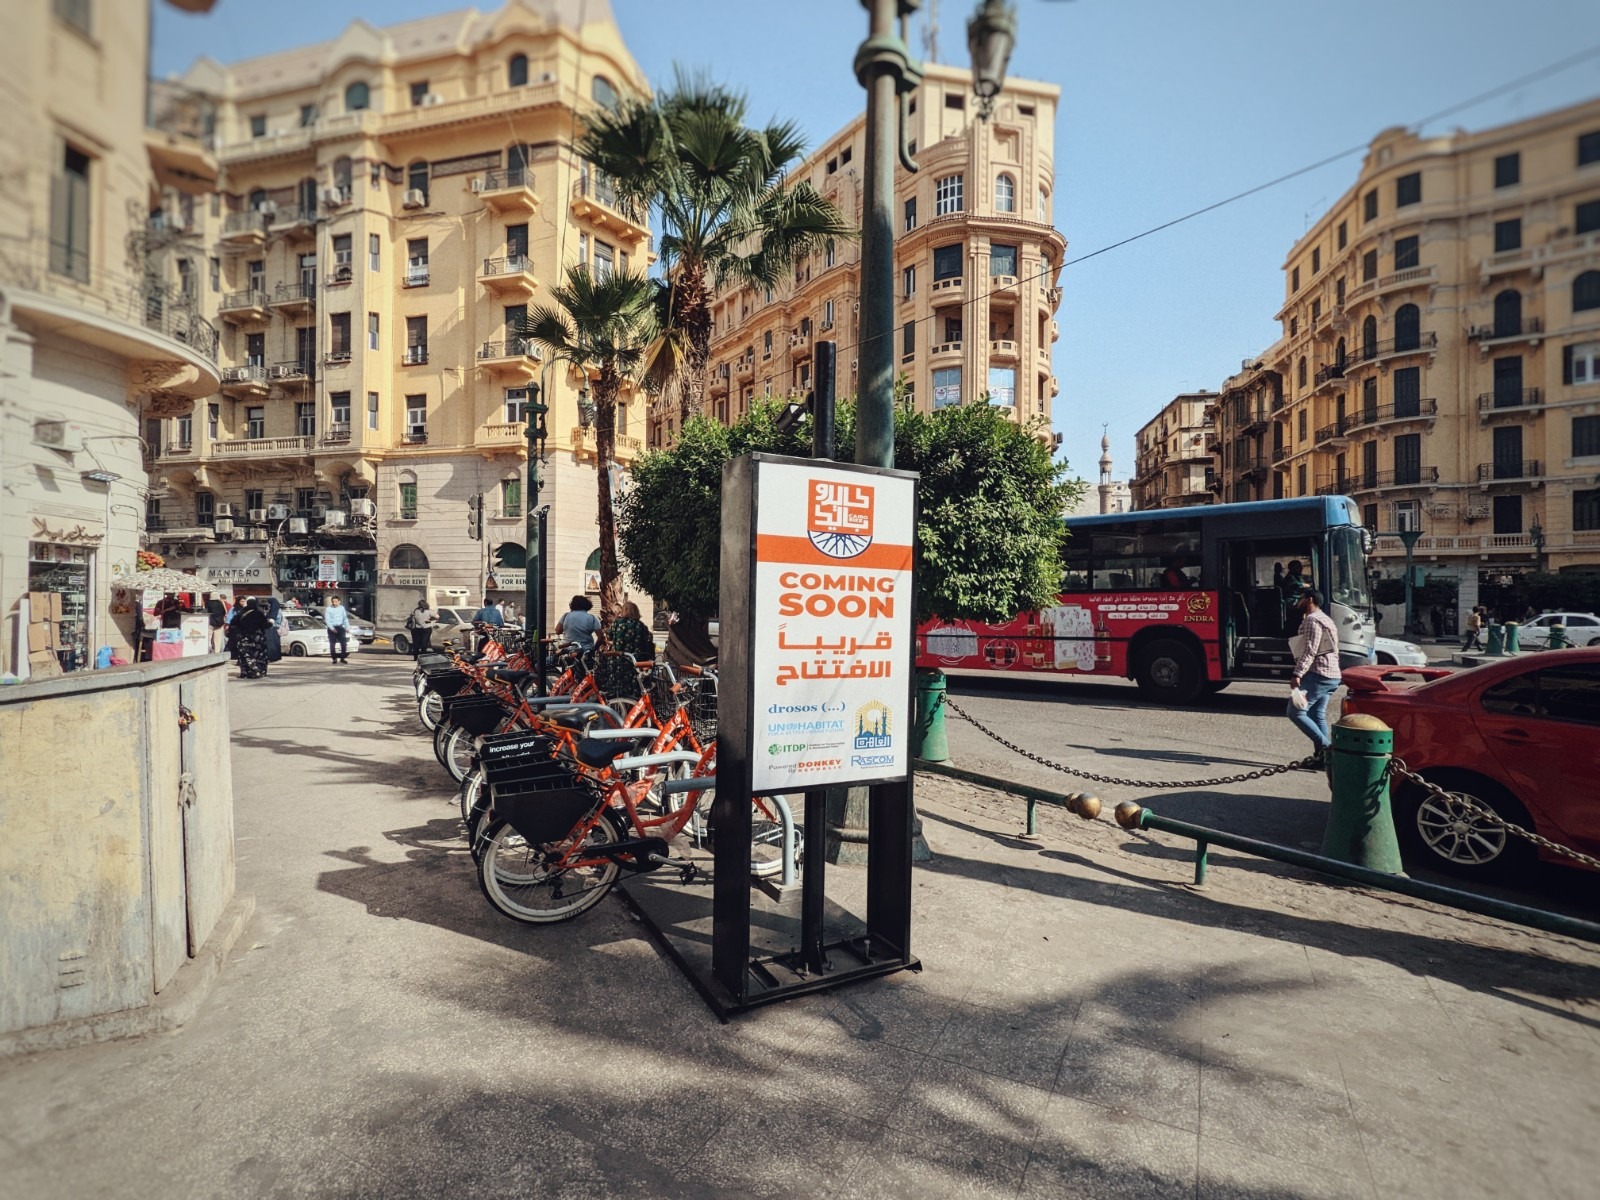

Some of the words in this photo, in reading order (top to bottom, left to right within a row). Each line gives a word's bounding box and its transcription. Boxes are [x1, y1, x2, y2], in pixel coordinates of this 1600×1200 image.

[208, 569, 260, 577] MANTERO
[779, 571, 894, 592] COMING
[778, 592, 894, 618] SOON
[776, 660, 891, 685] الافتتاح
[768, 704, 817, 714] drosos
[489, 744, 519, 753] increase
[520, 741, 535, 749] your
[783, 744, 806, 752] ITDP
[798, 759, 842, 768] DONKEY
